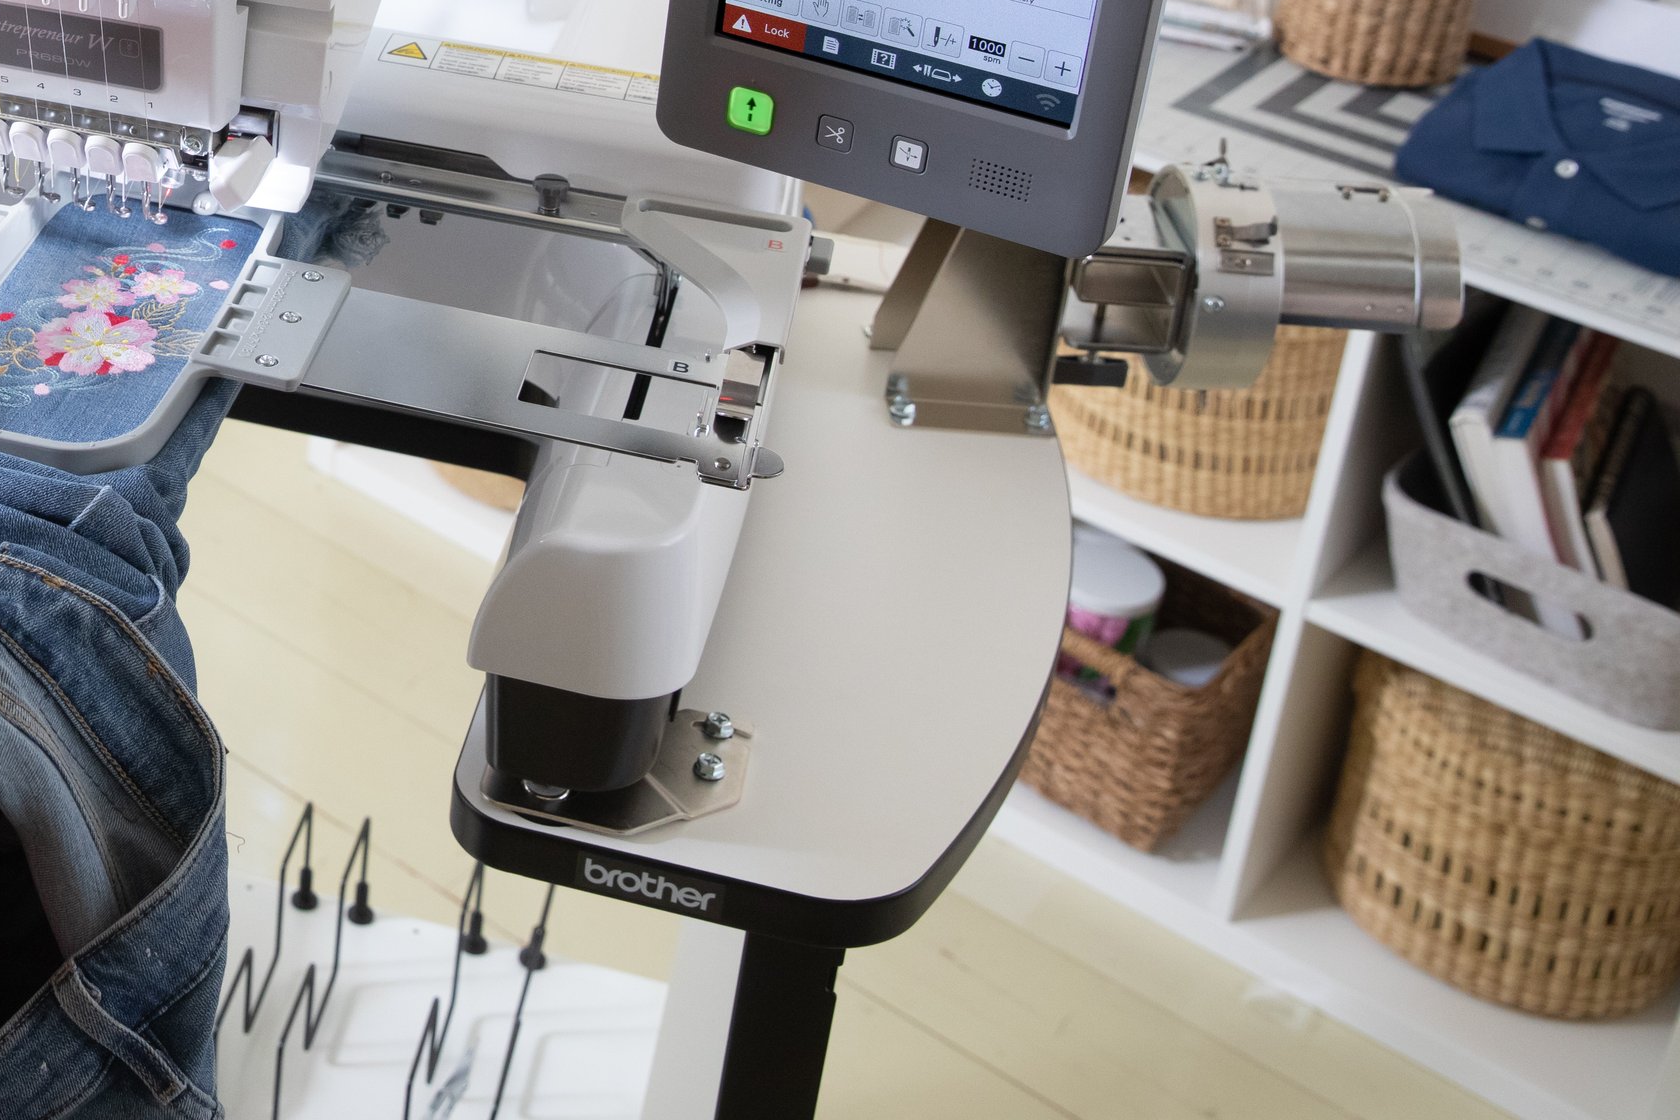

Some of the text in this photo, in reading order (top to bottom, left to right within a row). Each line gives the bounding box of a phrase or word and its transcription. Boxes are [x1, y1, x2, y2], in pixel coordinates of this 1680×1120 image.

[764, 23, 790, 39] Lock
[87, 33, 115, 50] W
[971, 38, 1005, 56] 1000
[983, 54, 1002, 65] spm
[1, 75, 9, 83] 5
[73, 88, 82, 96] 3
[147, 101, 153, 109] 1
[768, 239, 783, 250] B
[673, 361, 689, 374] B
[584, 857, 716, 912] brother
